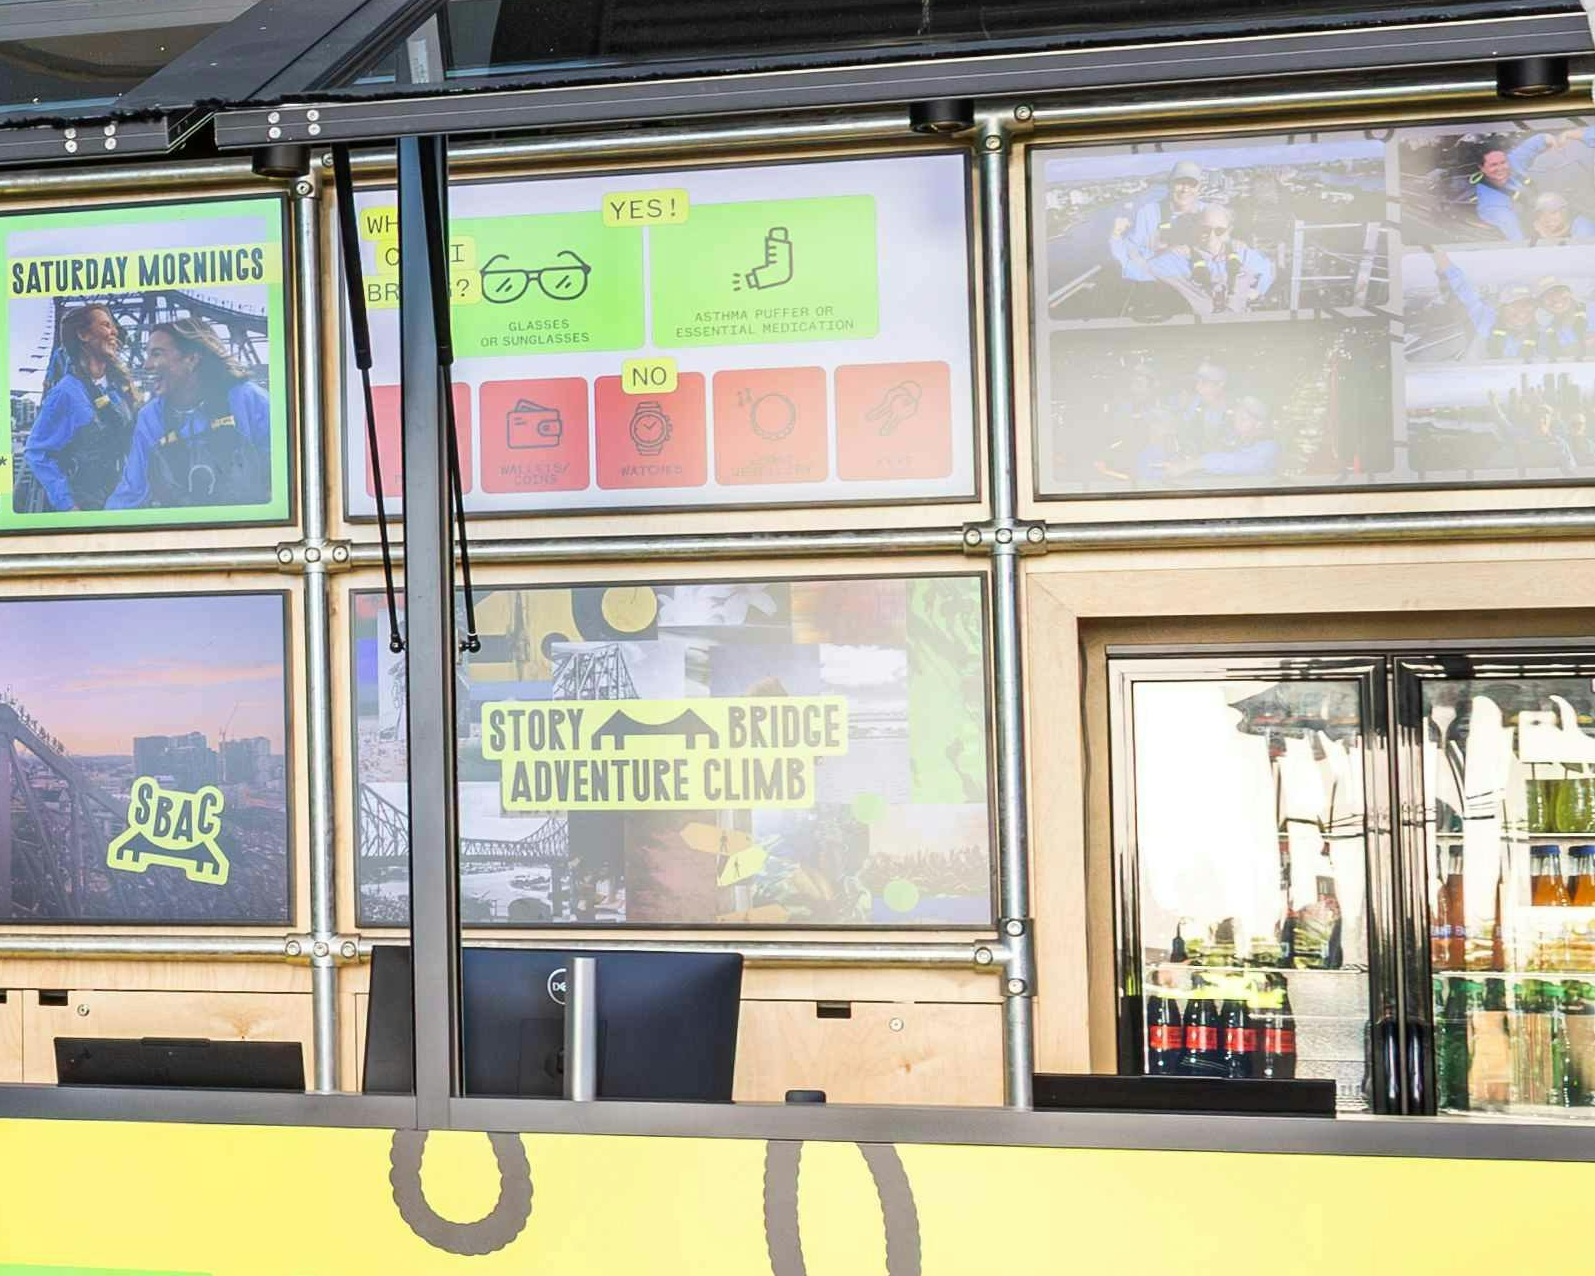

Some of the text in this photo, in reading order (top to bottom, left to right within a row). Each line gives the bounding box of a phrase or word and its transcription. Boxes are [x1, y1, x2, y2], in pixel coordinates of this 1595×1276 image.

[610, 198, 675, 220] YES!
[367, 215, 398, 234] WH
[12, 246, 265, 295] SATURDAY MORNINGS
[694, 306, 834, 322] ASTHMA PUFFER OR
[508, 319, 570, 332] GLASSES
[676, 319, 854, 338] ESSENTIAL MEDICATION
[480, 332, 590, 348] OR SUNGLASSES
[632, 366, 667, 387] NO
[489, 704, 840, 752] STORY BRIDGE
[510, 756, 806, 803] ADVENTURE CLIMB
[135, 783, 218, 842] SBAC
